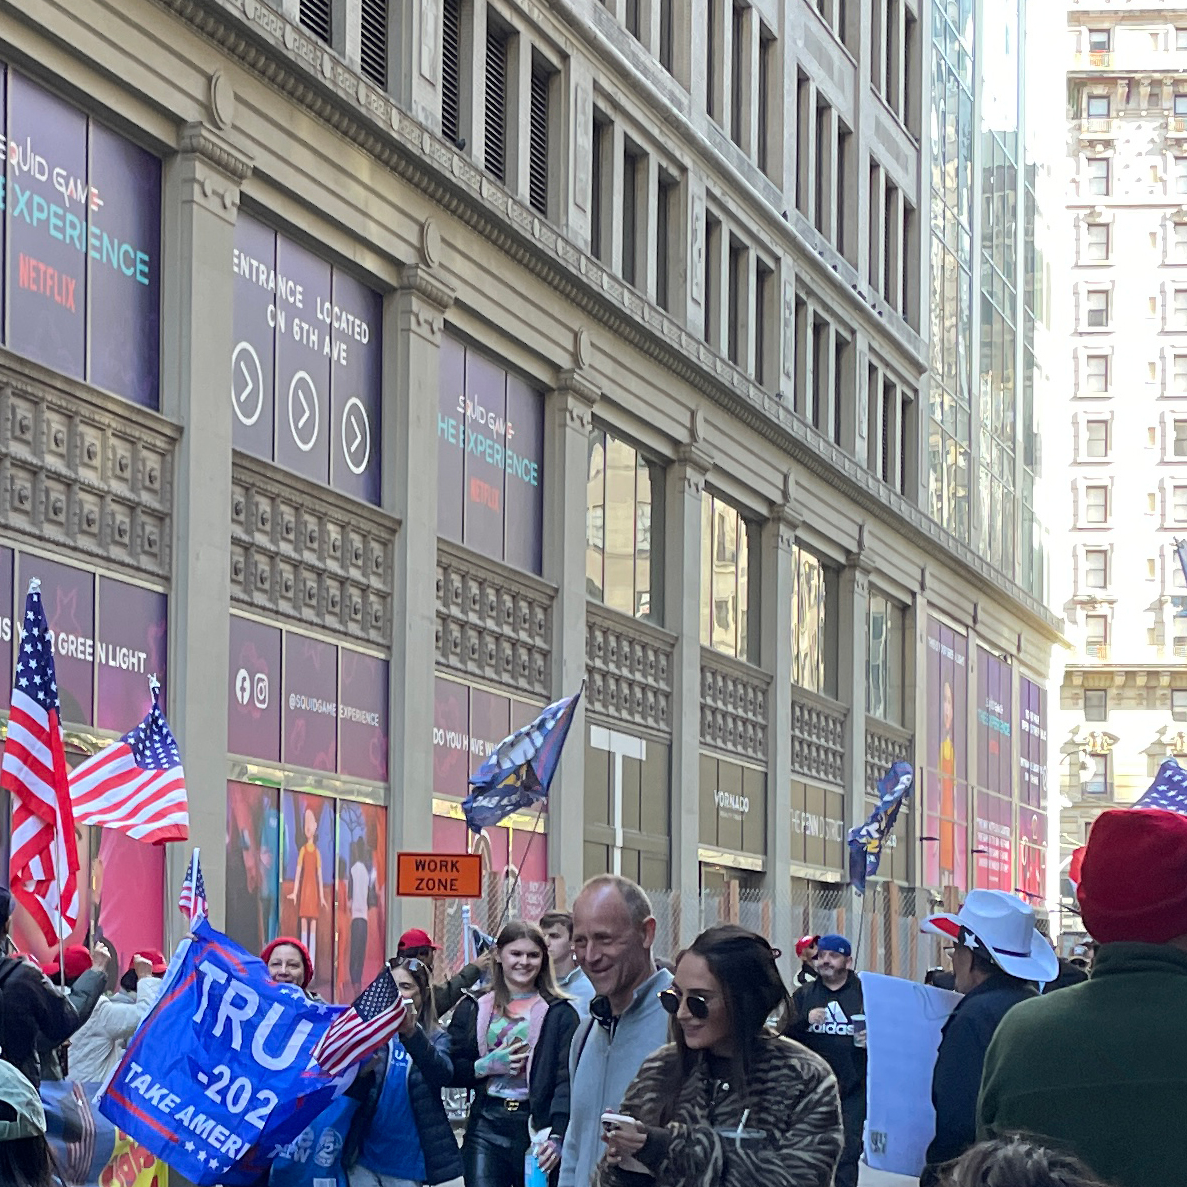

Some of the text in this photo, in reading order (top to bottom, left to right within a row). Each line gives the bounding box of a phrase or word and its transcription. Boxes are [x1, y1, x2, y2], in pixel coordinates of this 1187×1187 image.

[53, 167, 104, 211] GAME
[19, 252, 76, 313] NETFLIX
[233, 249, 370, 346] ENTRANCE LOCATED
[267, 304, 348, 366] ON 6TH AVE
[437, 412, 539, 487] HE EXPERIENCE
[58, 632, 107, 664] GREEN
[108, 645, 147, 674] LIGHT
[433, 727, 444, 745] DO
[445, 730, 462, 750] YOU
[414, 858, 460, 873] WORK
[414, 877, 459, 892] ZONE
[192, 959, 315, 1072] TRU
[124, 1061, 182, 1115] TAKE
[174, 1104, 251, 1161] AMERI
